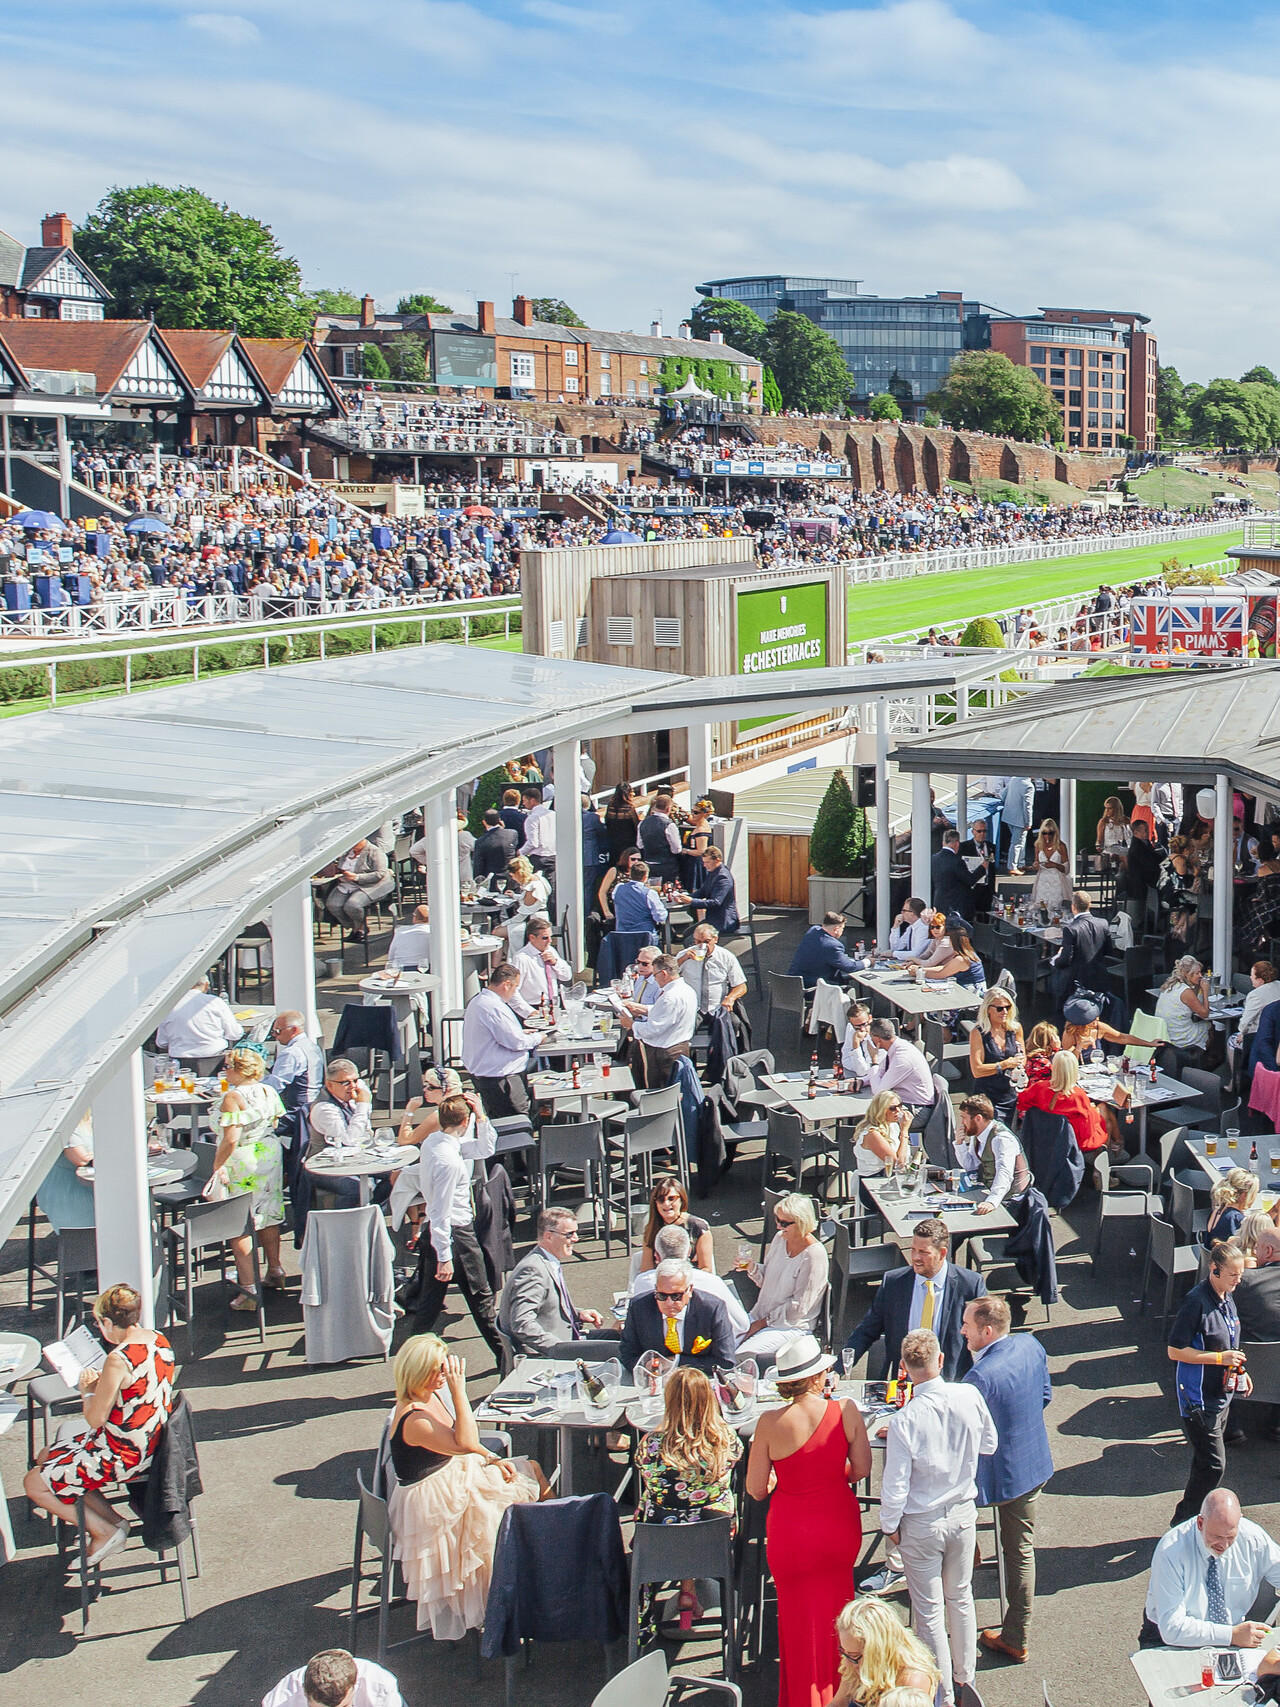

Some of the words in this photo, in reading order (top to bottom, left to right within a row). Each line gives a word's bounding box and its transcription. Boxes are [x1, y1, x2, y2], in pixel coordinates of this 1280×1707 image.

[760, 629, 777, 644] MAKE
[777, 623, 807, 640] MEMORIES
[1185, 632, 1228, 649] PIMM'S
[743, 638, 821, 674] #CHESTERRACES
